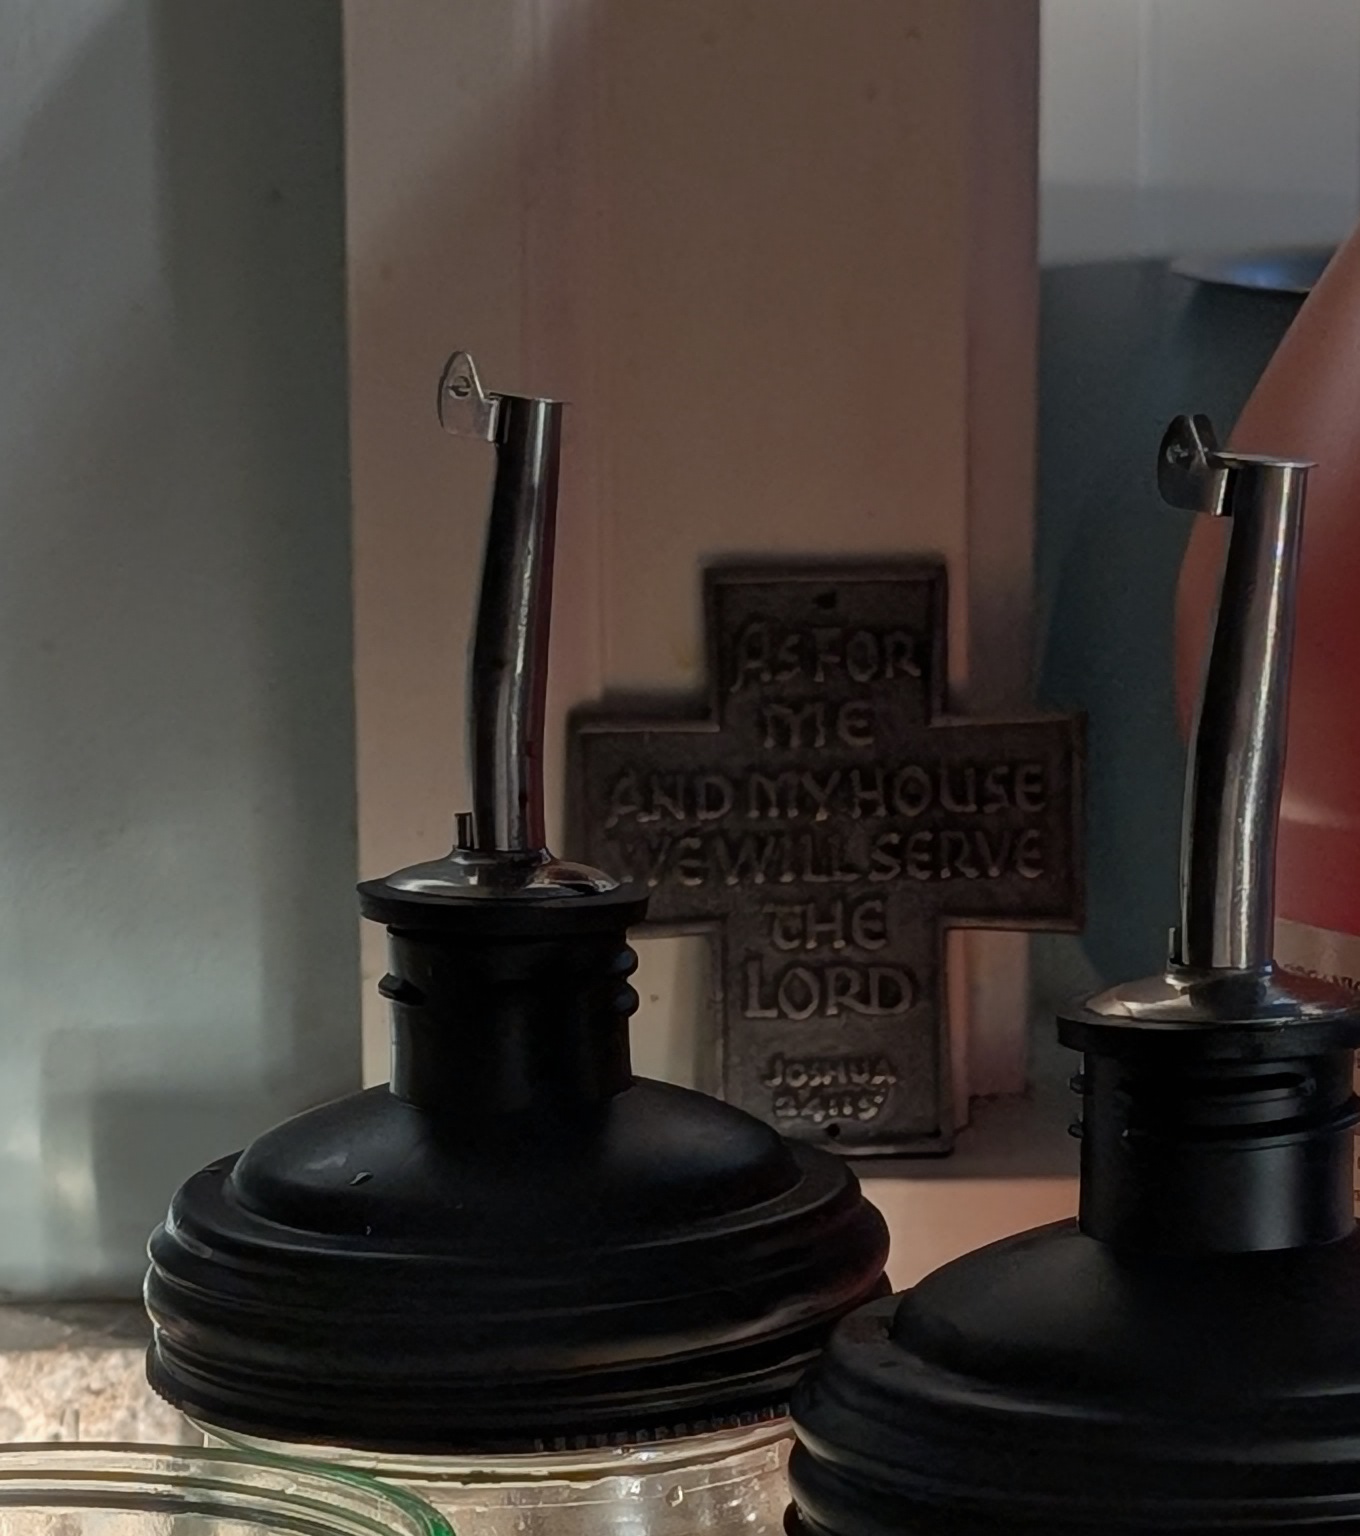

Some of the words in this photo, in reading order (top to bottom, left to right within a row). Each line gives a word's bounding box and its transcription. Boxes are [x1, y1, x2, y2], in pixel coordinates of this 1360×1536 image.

[762, 702, 875, 749] ME
[848, 764, 1046, 818] HOUSE
[868, 829, 1045, 882] SERVE
[766, 900, 887, 950] THE
[745, 958, 915, 1020] LORD
